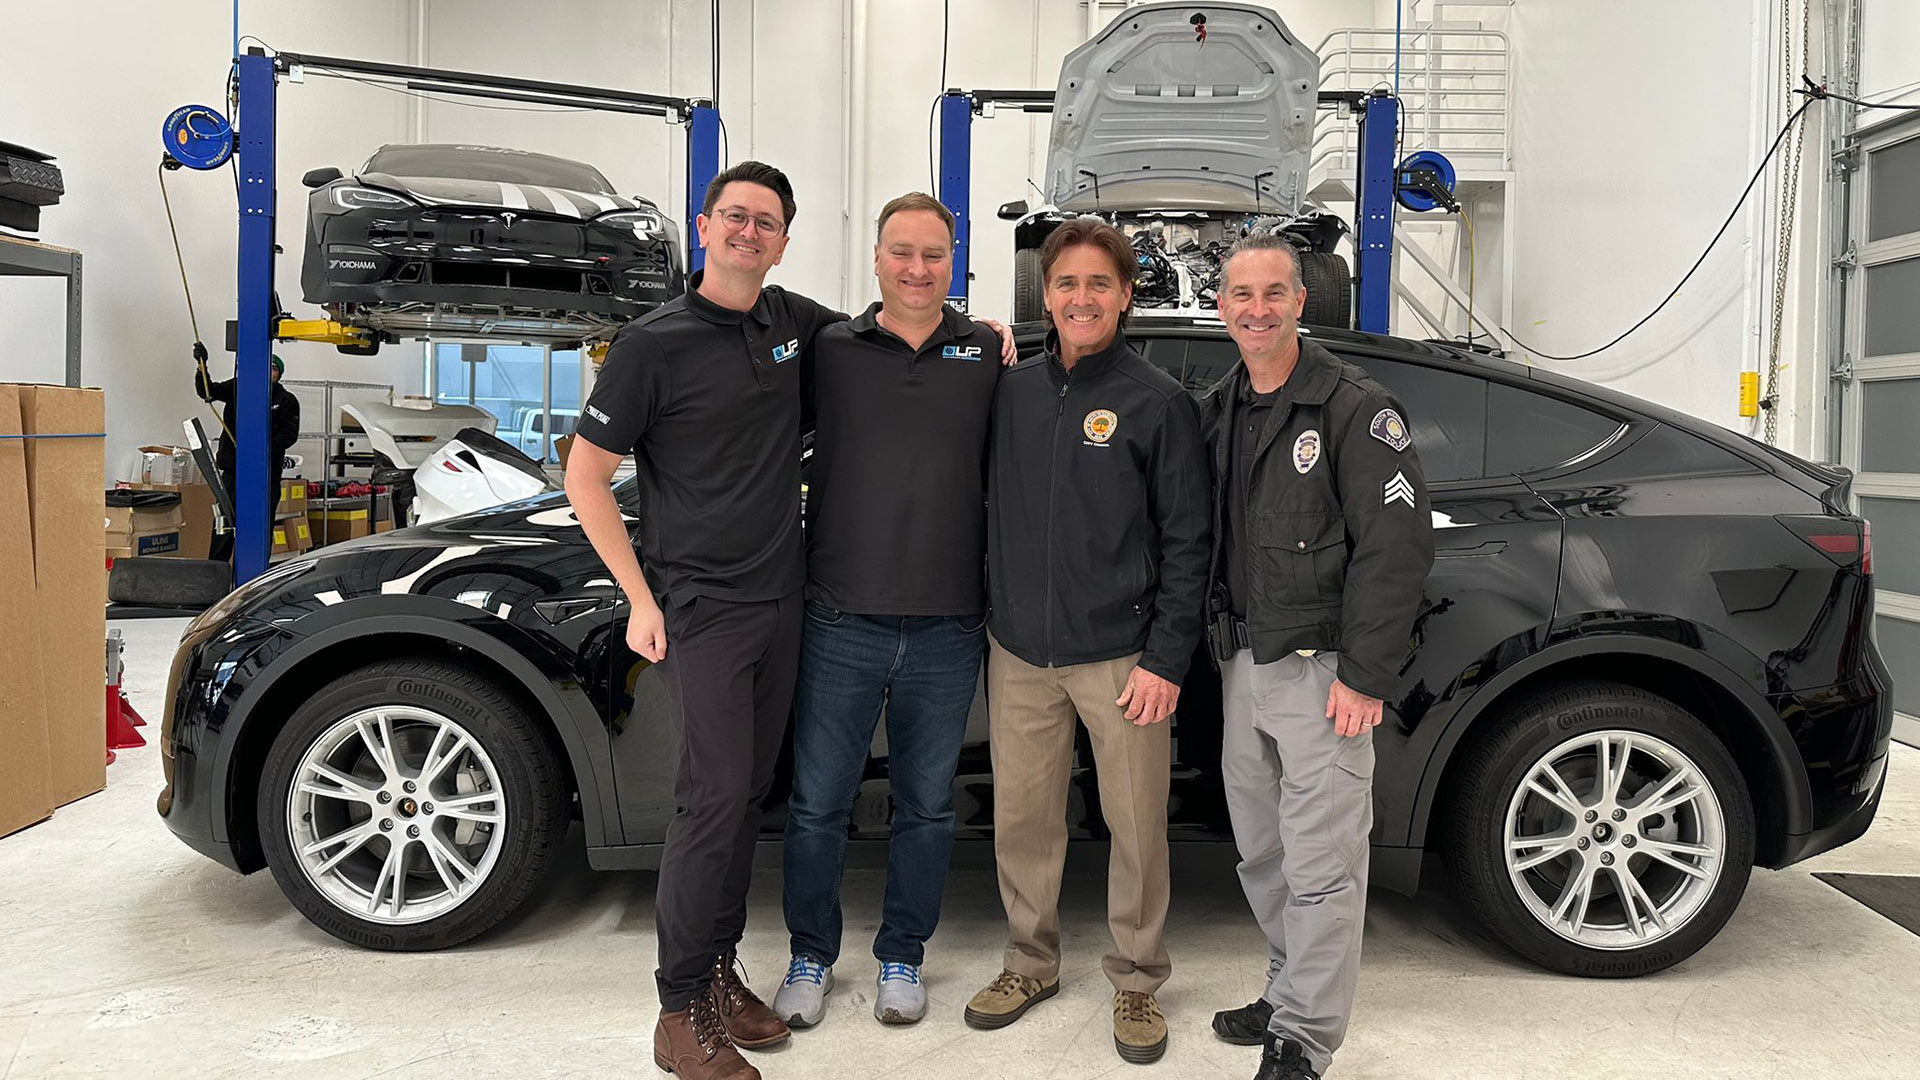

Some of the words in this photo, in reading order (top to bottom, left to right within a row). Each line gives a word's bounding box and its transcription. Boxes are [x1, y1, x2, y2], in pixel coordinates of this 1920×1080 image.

[337, 260, 377, 270] YOKOHAMA
[955, 345, 982, 357] UP
[152, 536, 169, 546] ULINE
[397, 679, 483, 719] Continental
[1557, 705, 1644, 730] Continental
